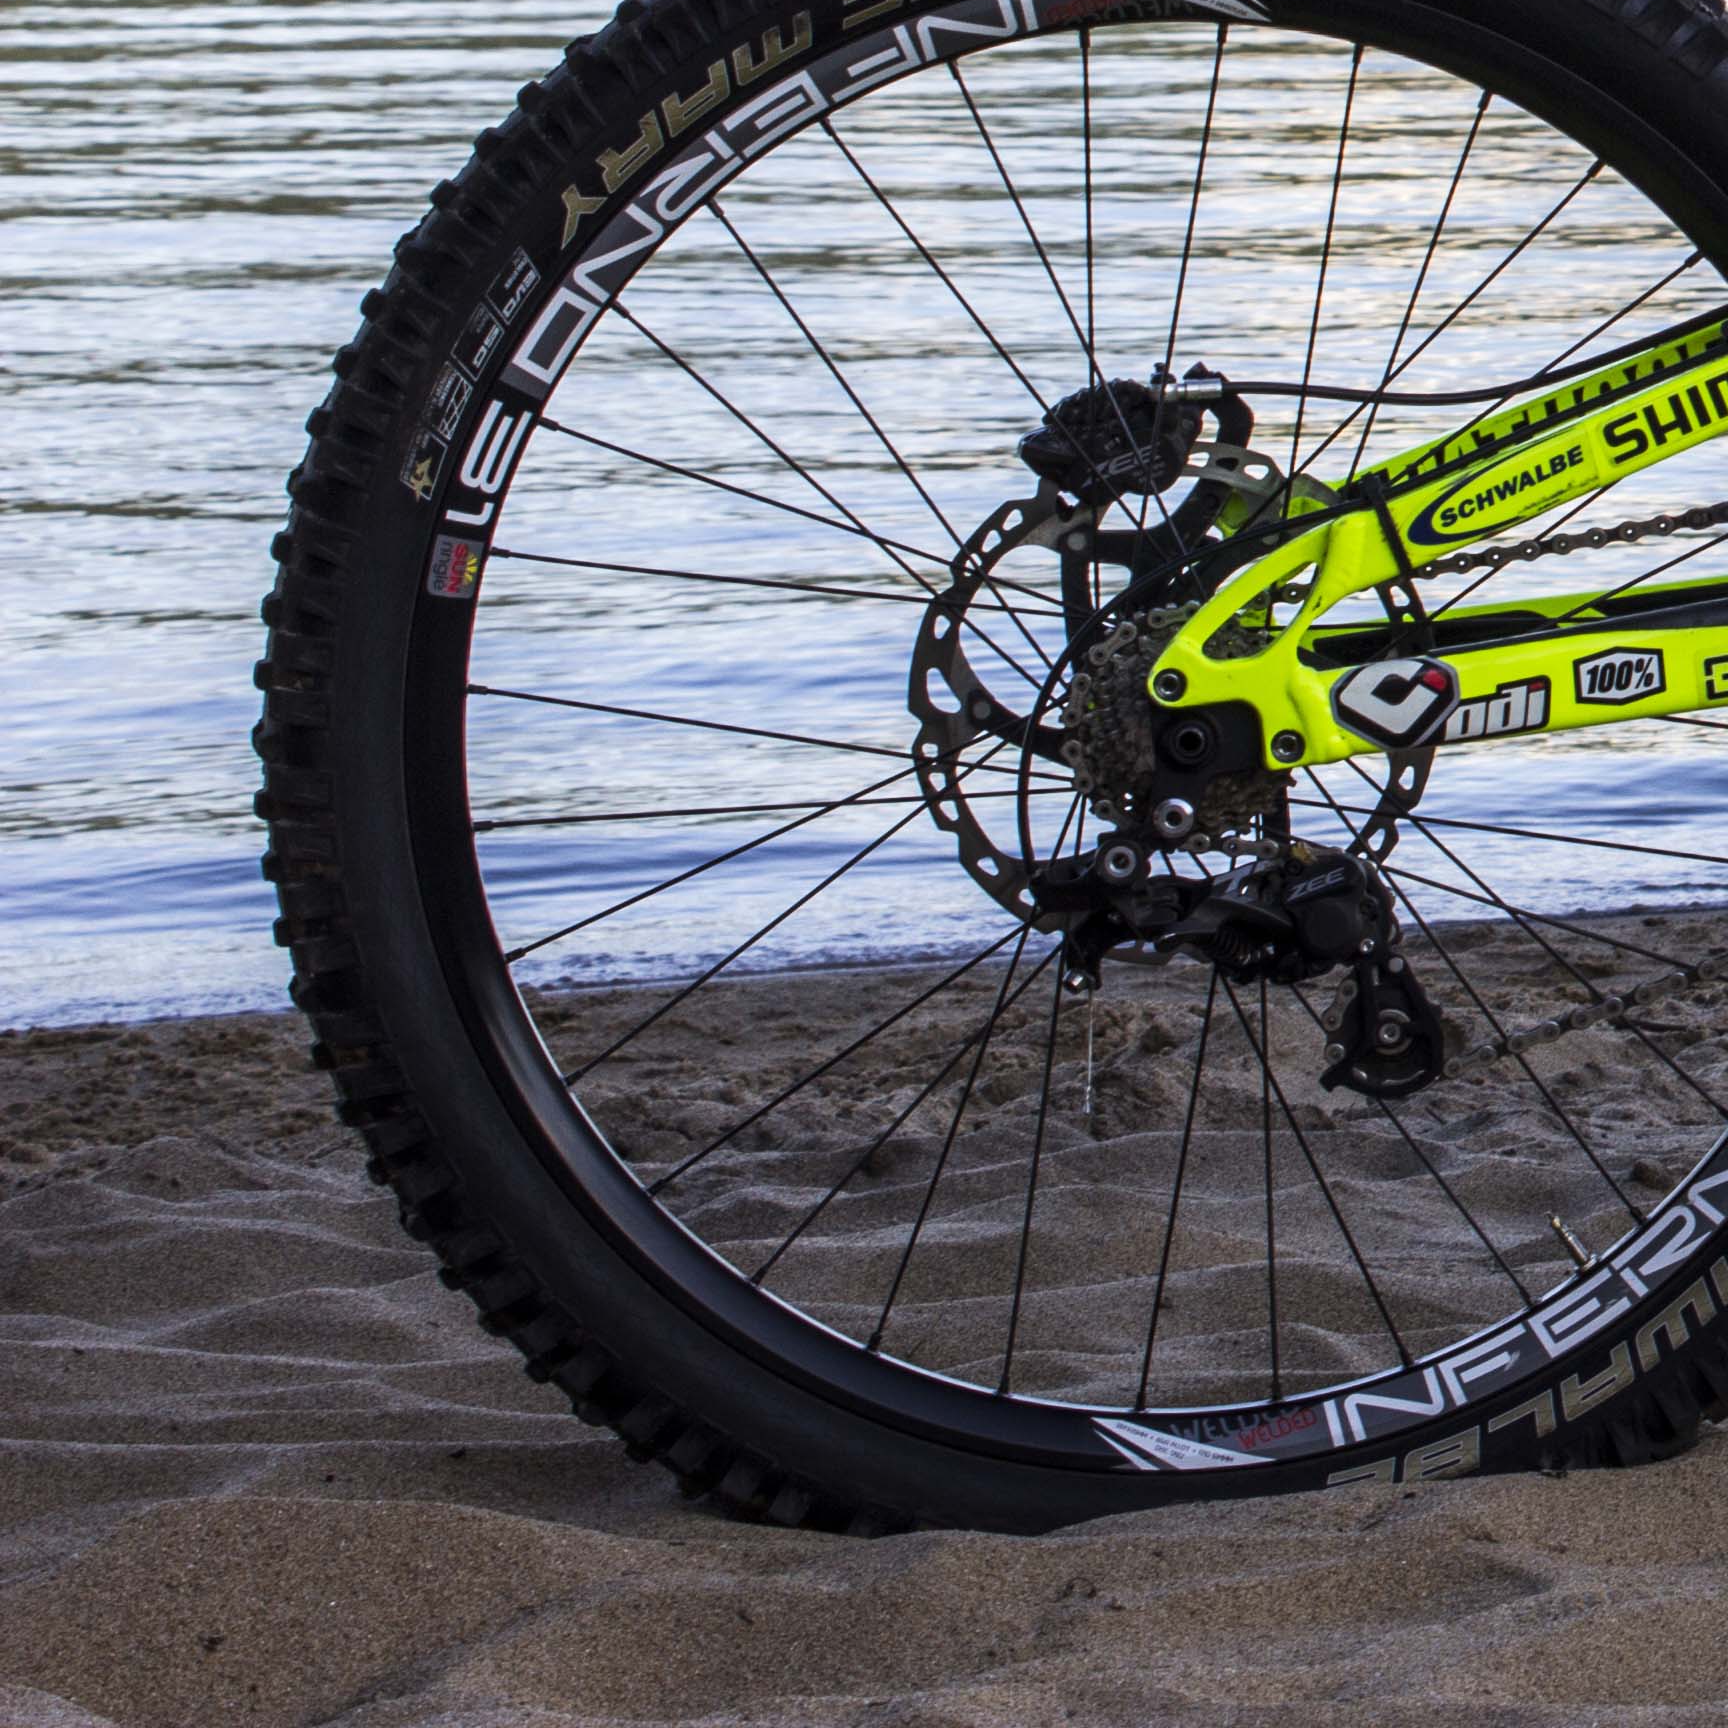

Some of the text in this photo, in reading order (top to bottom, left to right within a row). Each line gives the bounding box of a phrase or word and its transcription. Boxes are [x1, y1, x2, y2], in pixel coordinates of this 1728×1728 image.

[560, 11, 813, 249] MARY
[1440, 445, 1584, 528] SCHWALBE
[1586, 657, 1656, 695] 100%
[1444, 680, 1546, 742] odi
[1286, 866, 1345, 904] ZEE
